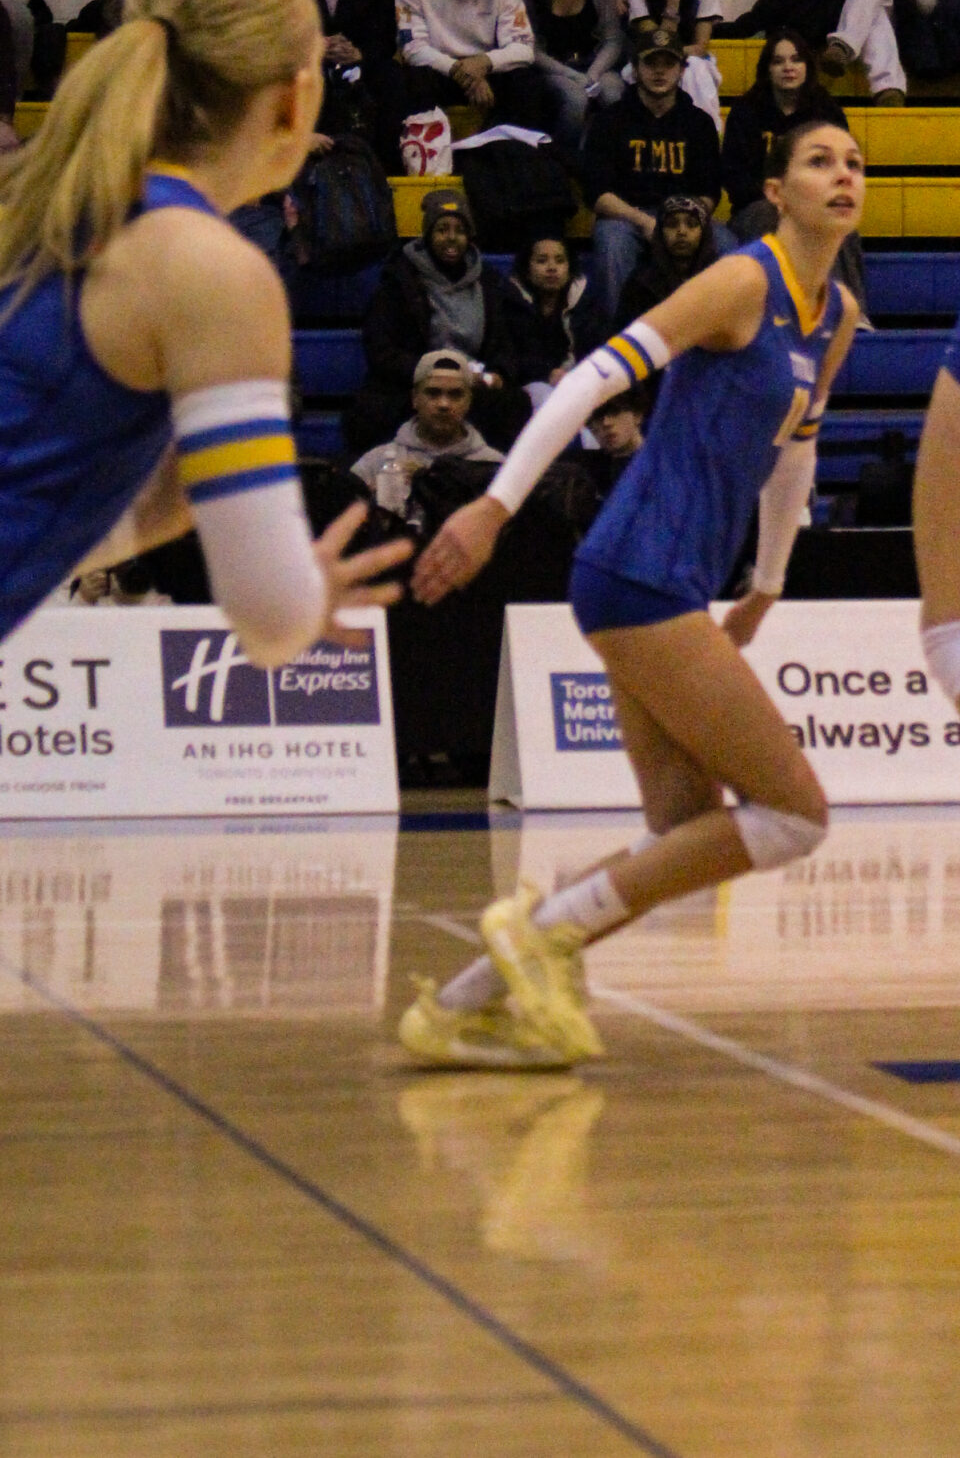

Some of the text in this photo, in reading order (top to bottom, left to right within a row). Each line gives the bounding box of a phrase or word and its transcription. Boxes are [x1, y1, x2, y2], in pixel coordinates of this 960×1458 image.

[629, 139, 686, 174] TMU
[0, 658, 111, 710] ST
[280, 668, 372, 696] Express
[560, 680, 611, 699] Toro
[777, 661, 929, 696] Once a
[562, 702, 615, 720] Metr
[0, 723, 115, 757] otels
[183, 741, 368, 759] AN IHG HOTEL
